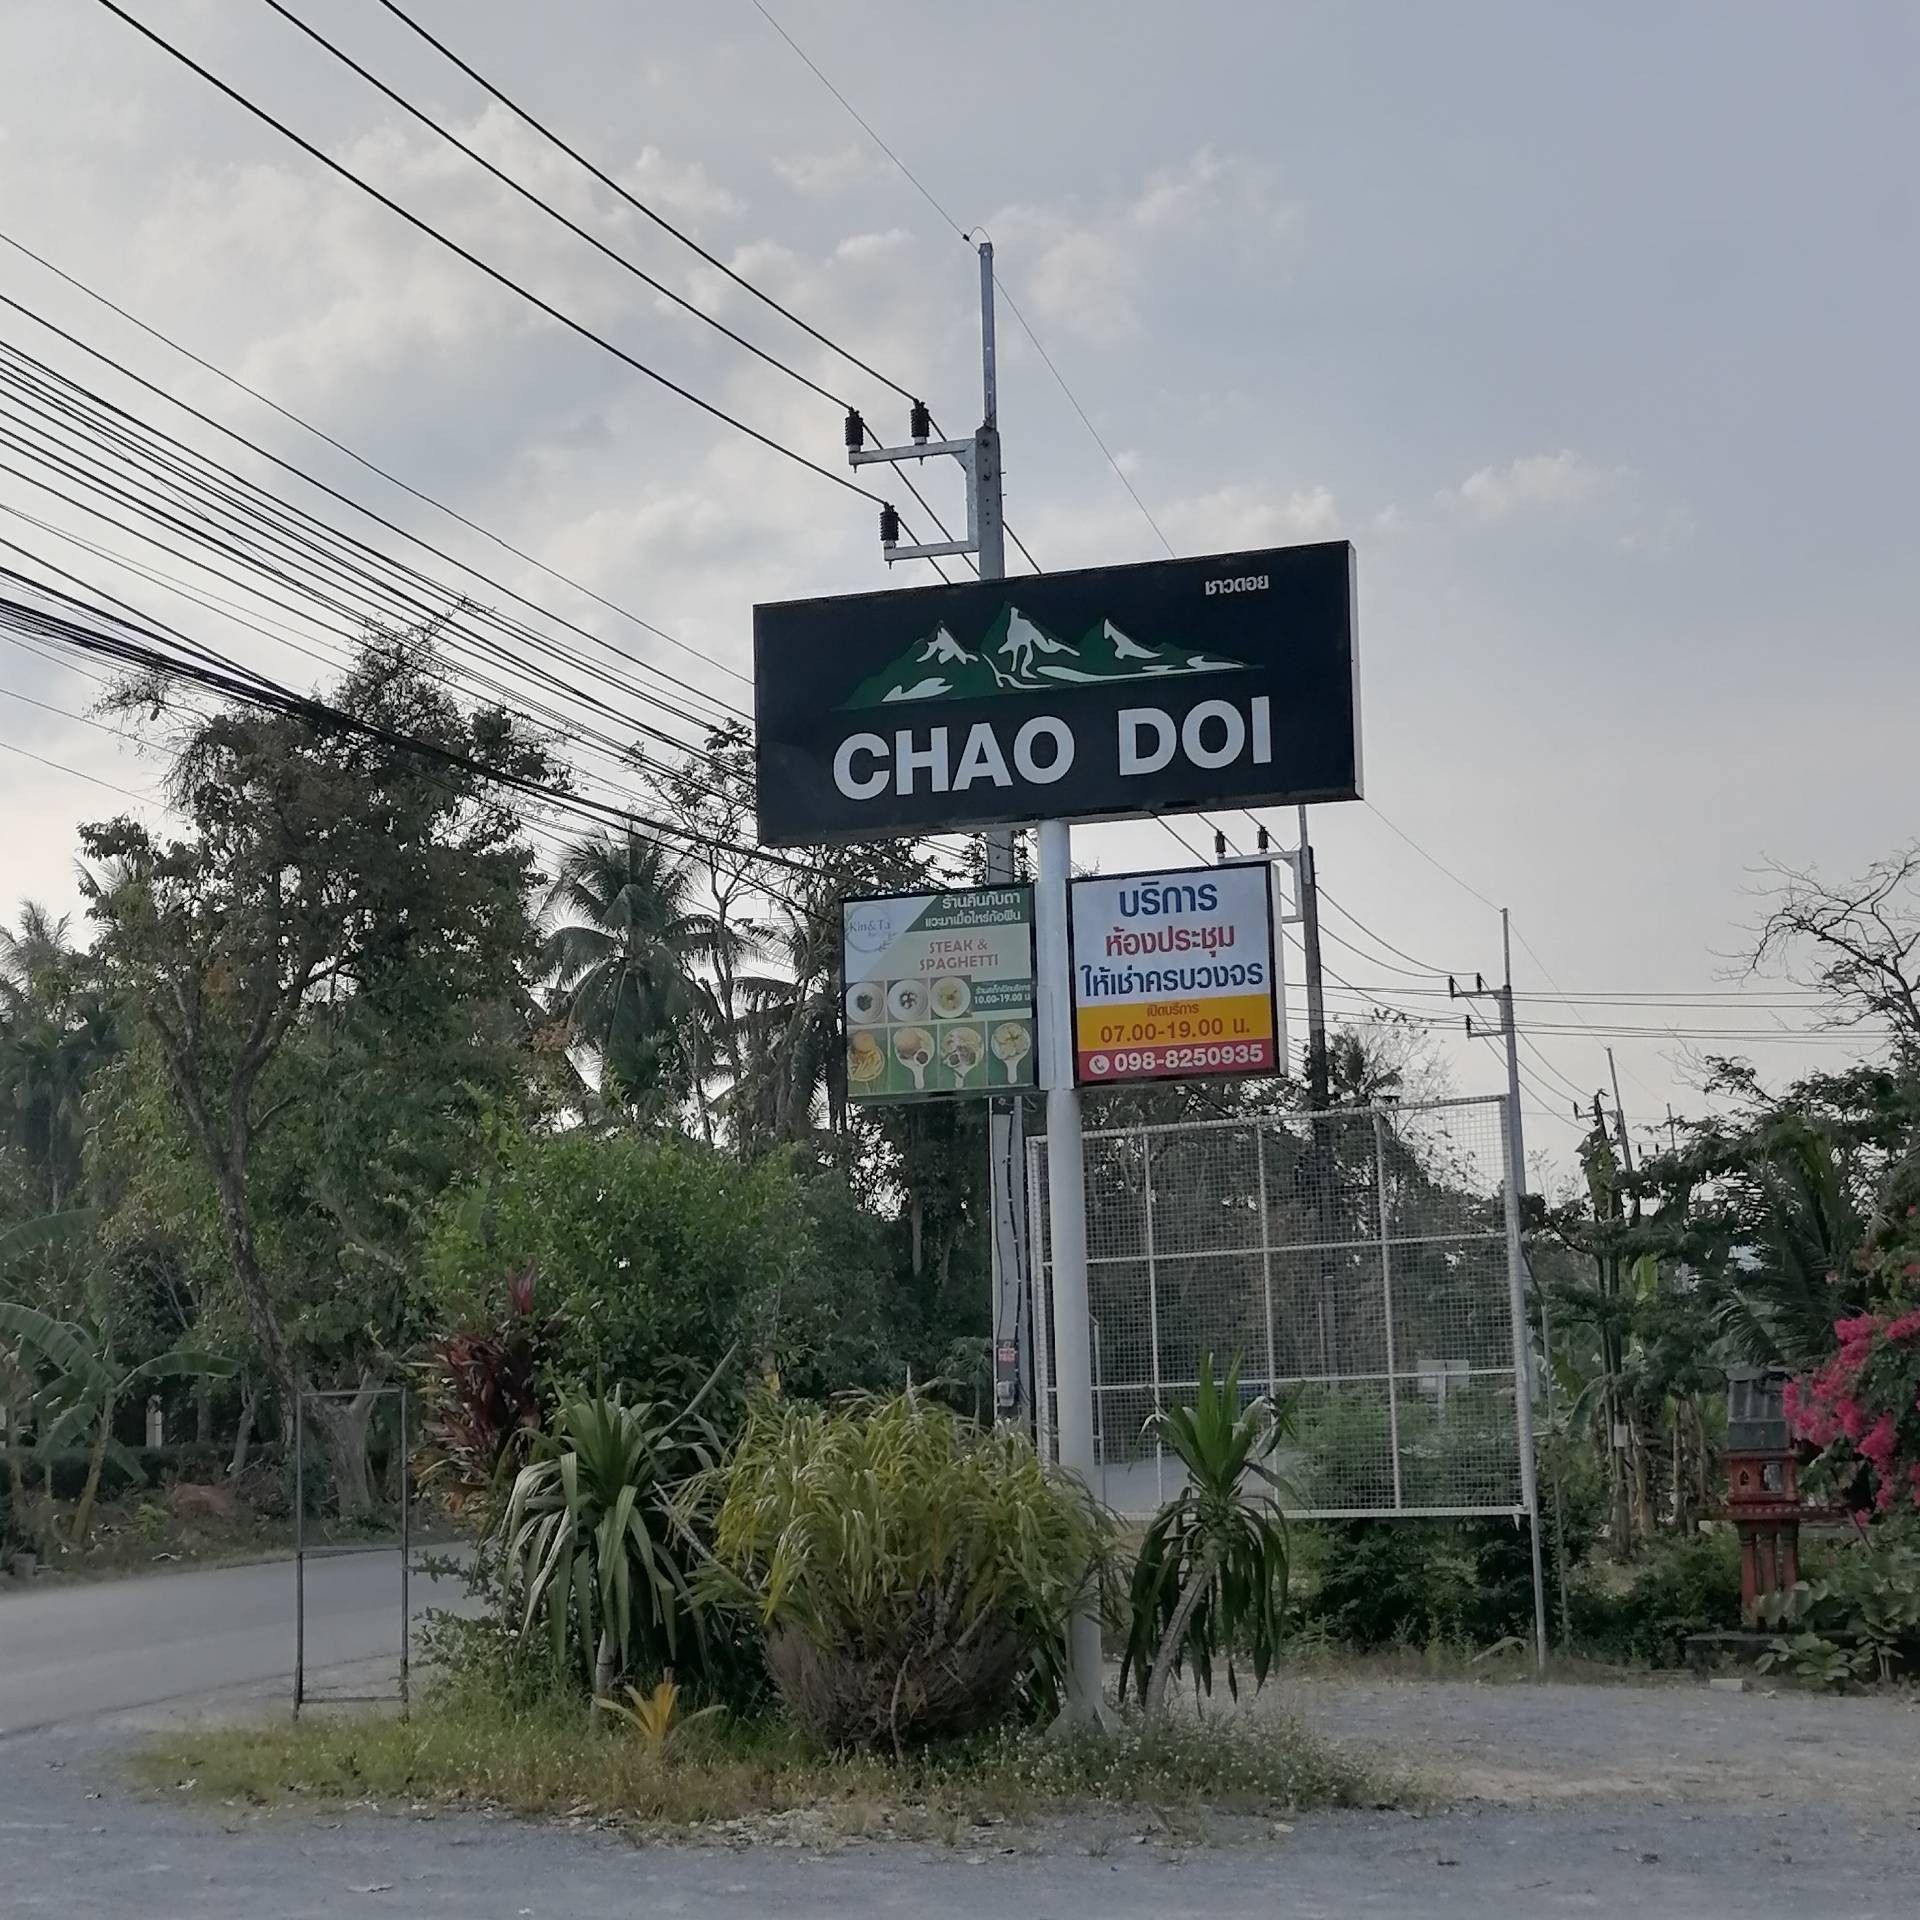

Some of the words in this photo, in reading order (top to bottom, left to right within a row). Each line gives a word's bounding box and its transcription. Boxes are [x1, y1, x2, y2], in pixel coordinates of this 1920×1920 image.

[1204, 574, 1269, 596] ชาวดอย
[833, 715, 1075, 801] CHAO
[1118, 696, 1272, 776] DOI
[1119, 880, 1218, 918] บริการ
[929, 939, 973, 954] STEAK
[977, 938, 988, 951] &
[1105, 925, 1235, 958] ห้องประชุม
[919, 954, 999, 972] SPAGHETTI
[1080, 962, 1264, 997] ให้เช่าครบวงจร
[1147, 1002, 1200, 1017] เปิดบริการ
[1100, 1018, 1223, 1044] 07.00-19.00
[1233, 1018, 1250, 1035] น.
[1114, 1044, 1264, 1072] 098-8250935
